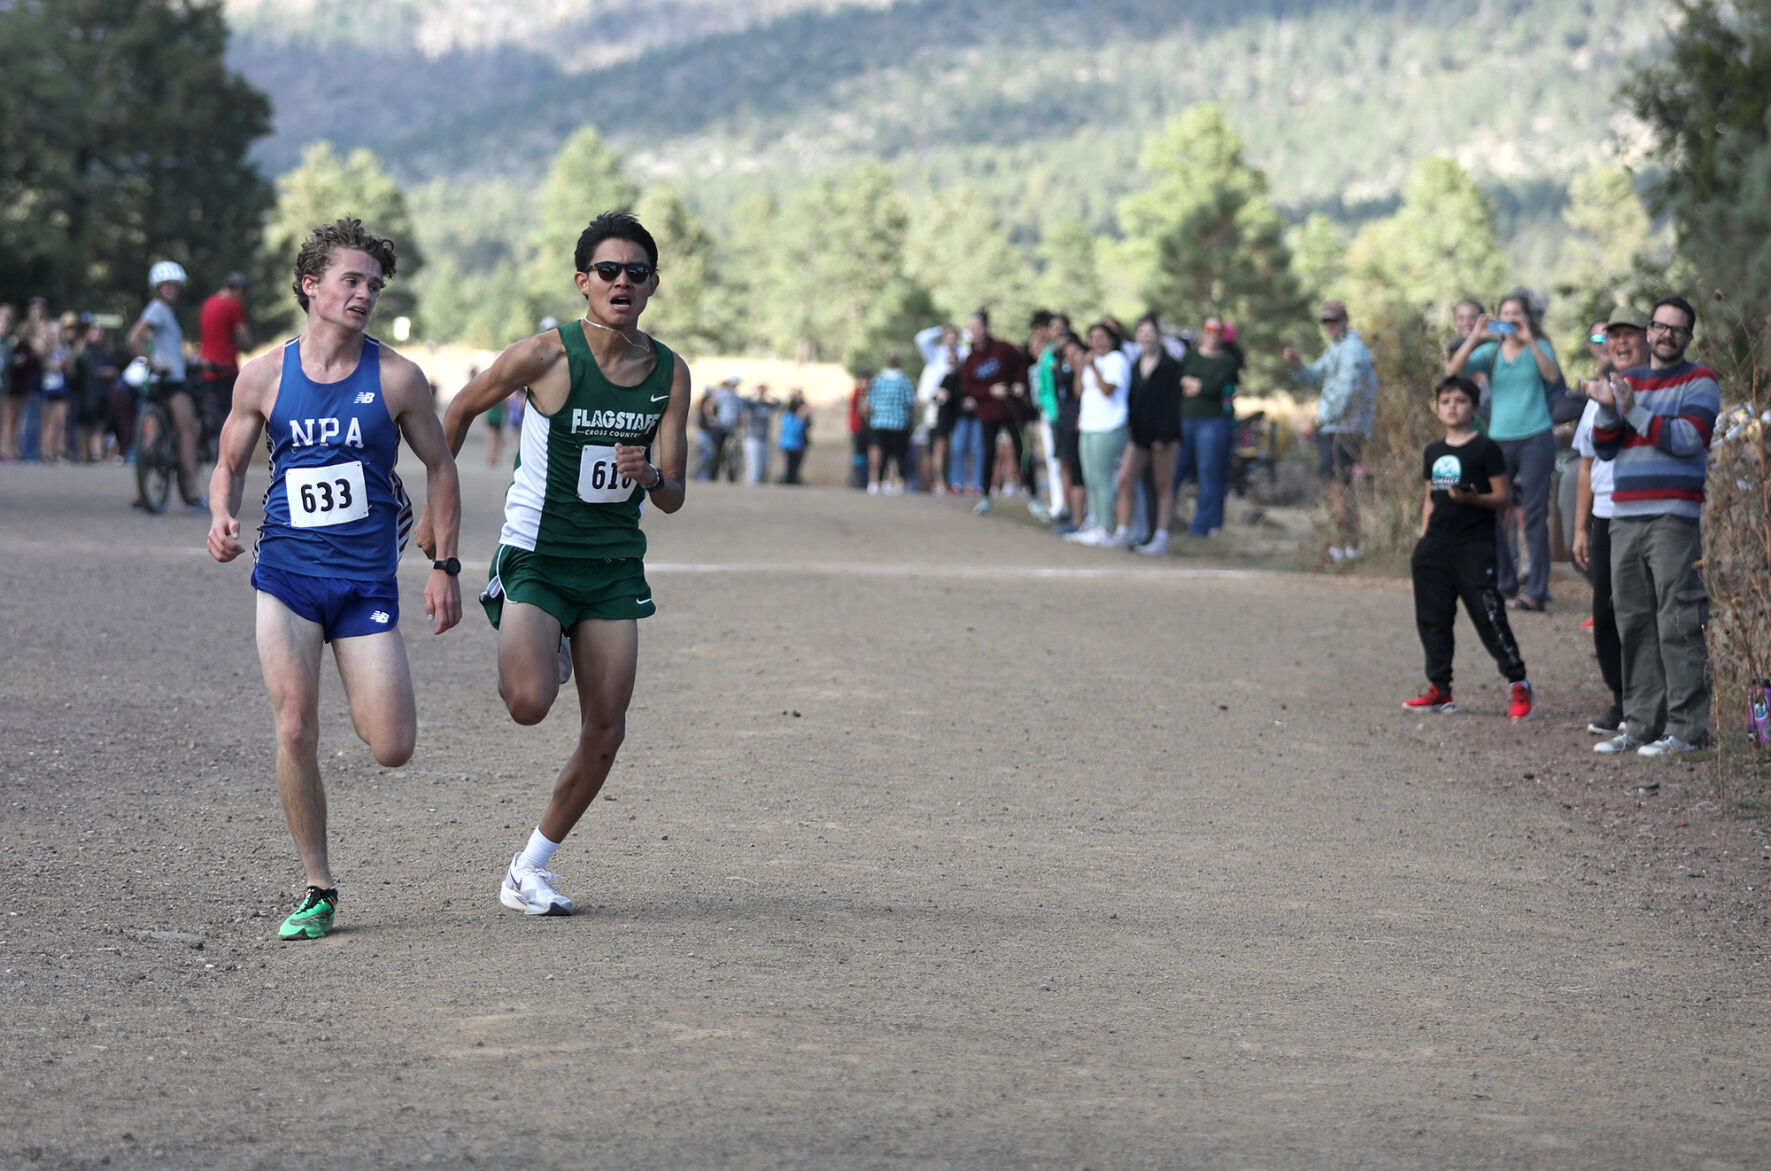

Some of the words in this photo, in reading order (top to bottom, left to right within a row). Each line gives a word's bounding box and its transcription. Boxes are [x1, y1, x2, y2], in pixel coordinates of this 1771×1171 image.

[289, 417, 364, 448] NPA
[571, 408, 661, 434] FLAGSTAFF
[300, 478, 353, 513] 633
